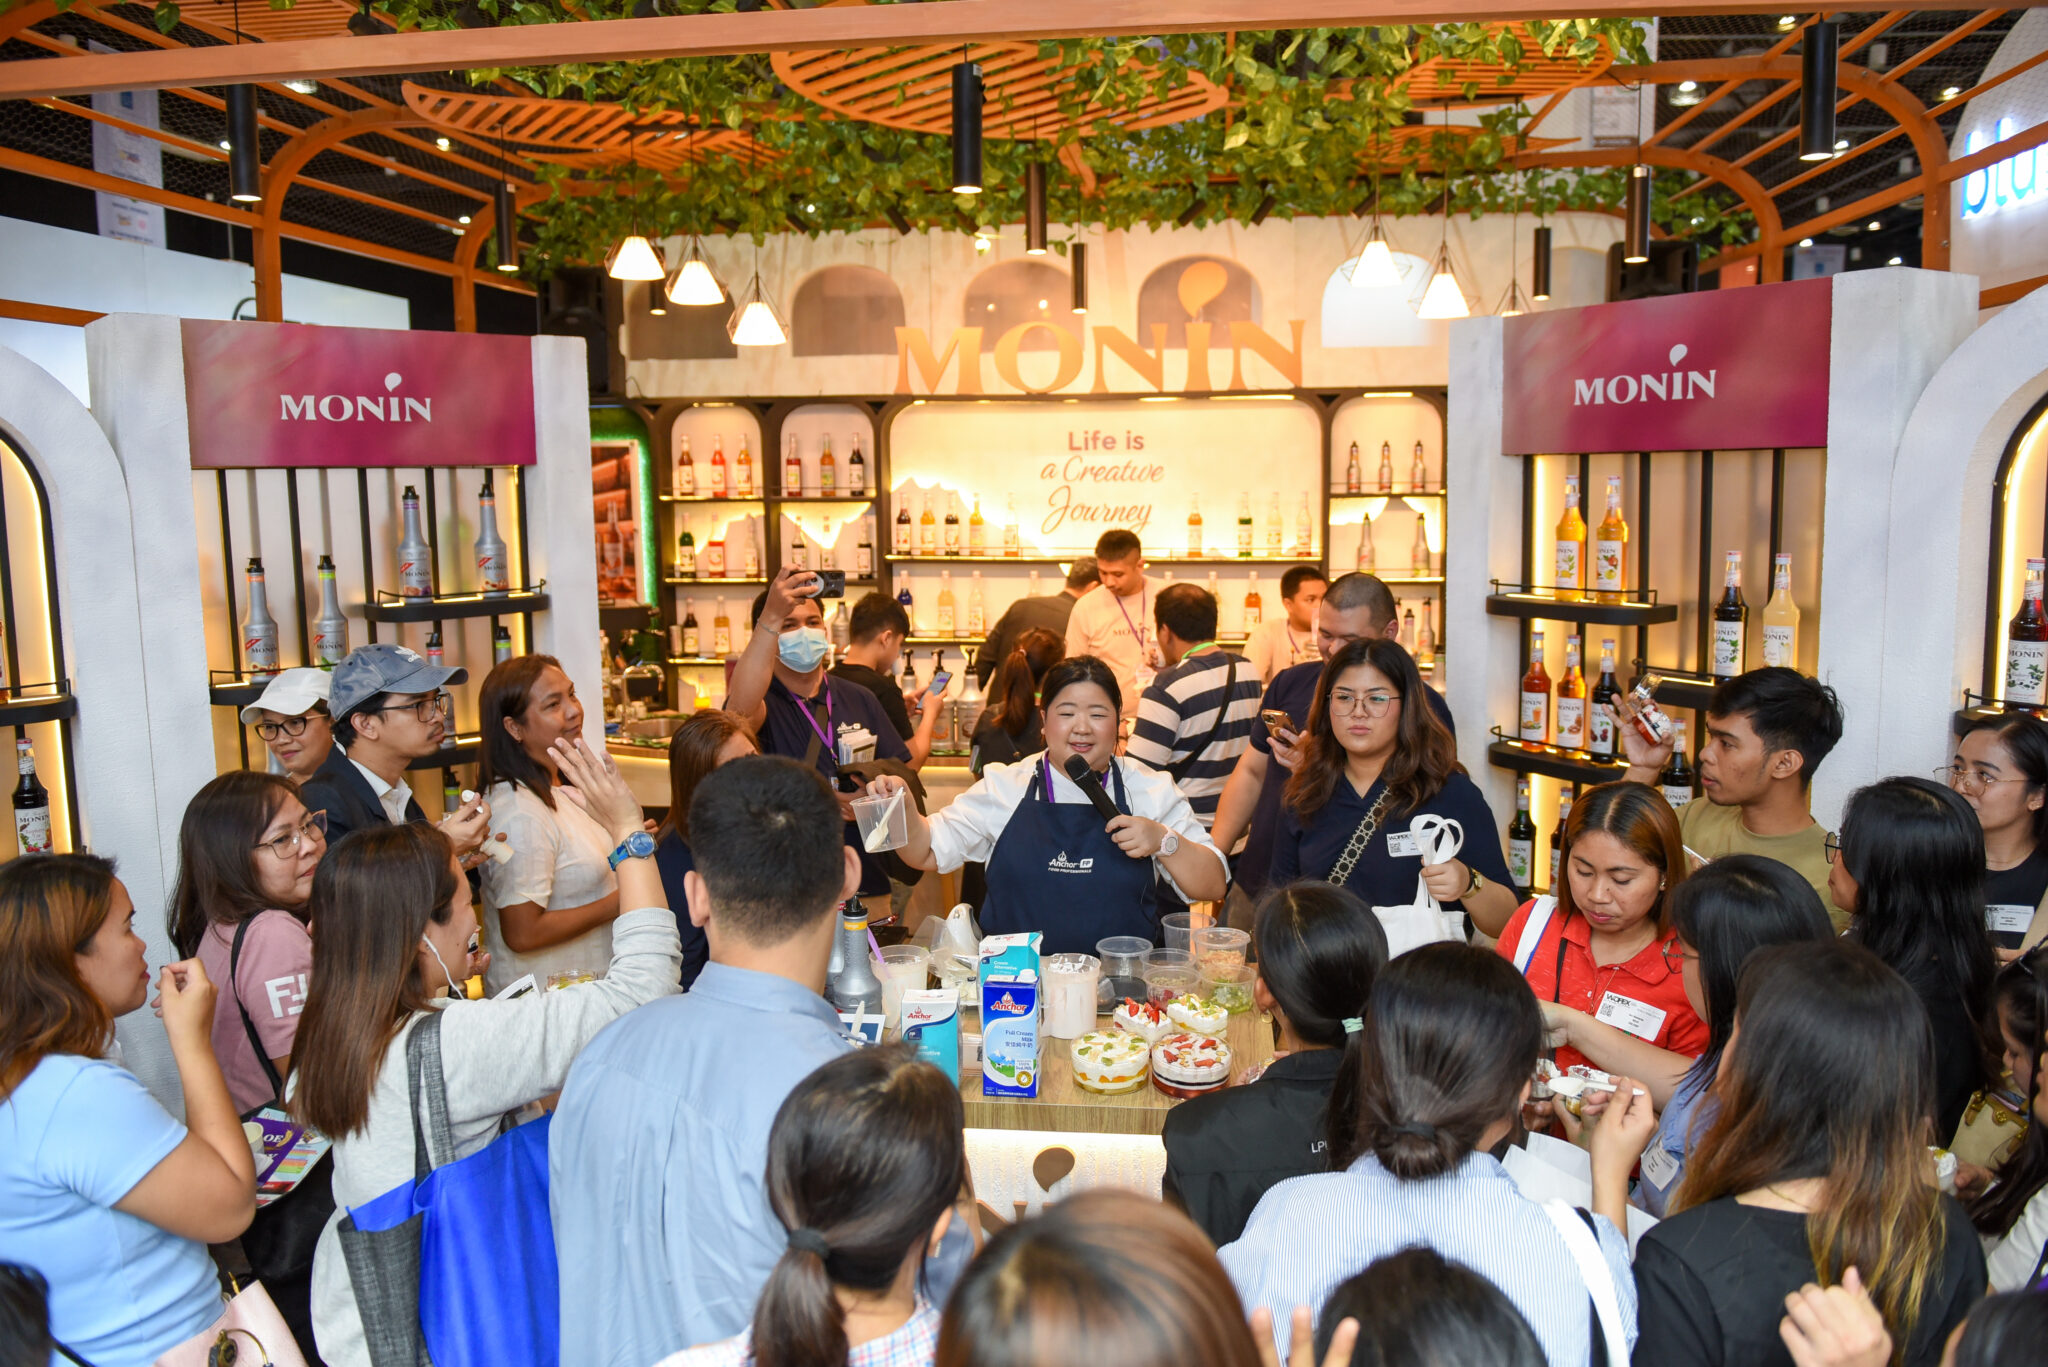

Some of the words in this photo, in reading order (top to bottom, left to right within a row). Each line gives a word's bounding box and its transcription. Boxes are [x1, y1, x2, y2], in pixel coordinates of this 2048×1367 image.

[1962, 117, 2048, 219] blu
[894, 320, 1305, 394] MONIN
[1574, 369, 1716, 406] MONIN
[280, 394, 431, 422] MONIN
[1068, 430, 1117, 451] Life
[1126, 430, 1145, 451] is
[1040, 463, 1057, 480] a
[1063, 455, 1165, 483] Creative
[1041, 485, 1152, 535] Journey
[1763, 633, 1790, 641] ONIN
[1049, 858, 1078, 868] Anchor
[907, 1012, 932, 1020] Anchor
[990, 1001, 1027, 1012] Anchor
